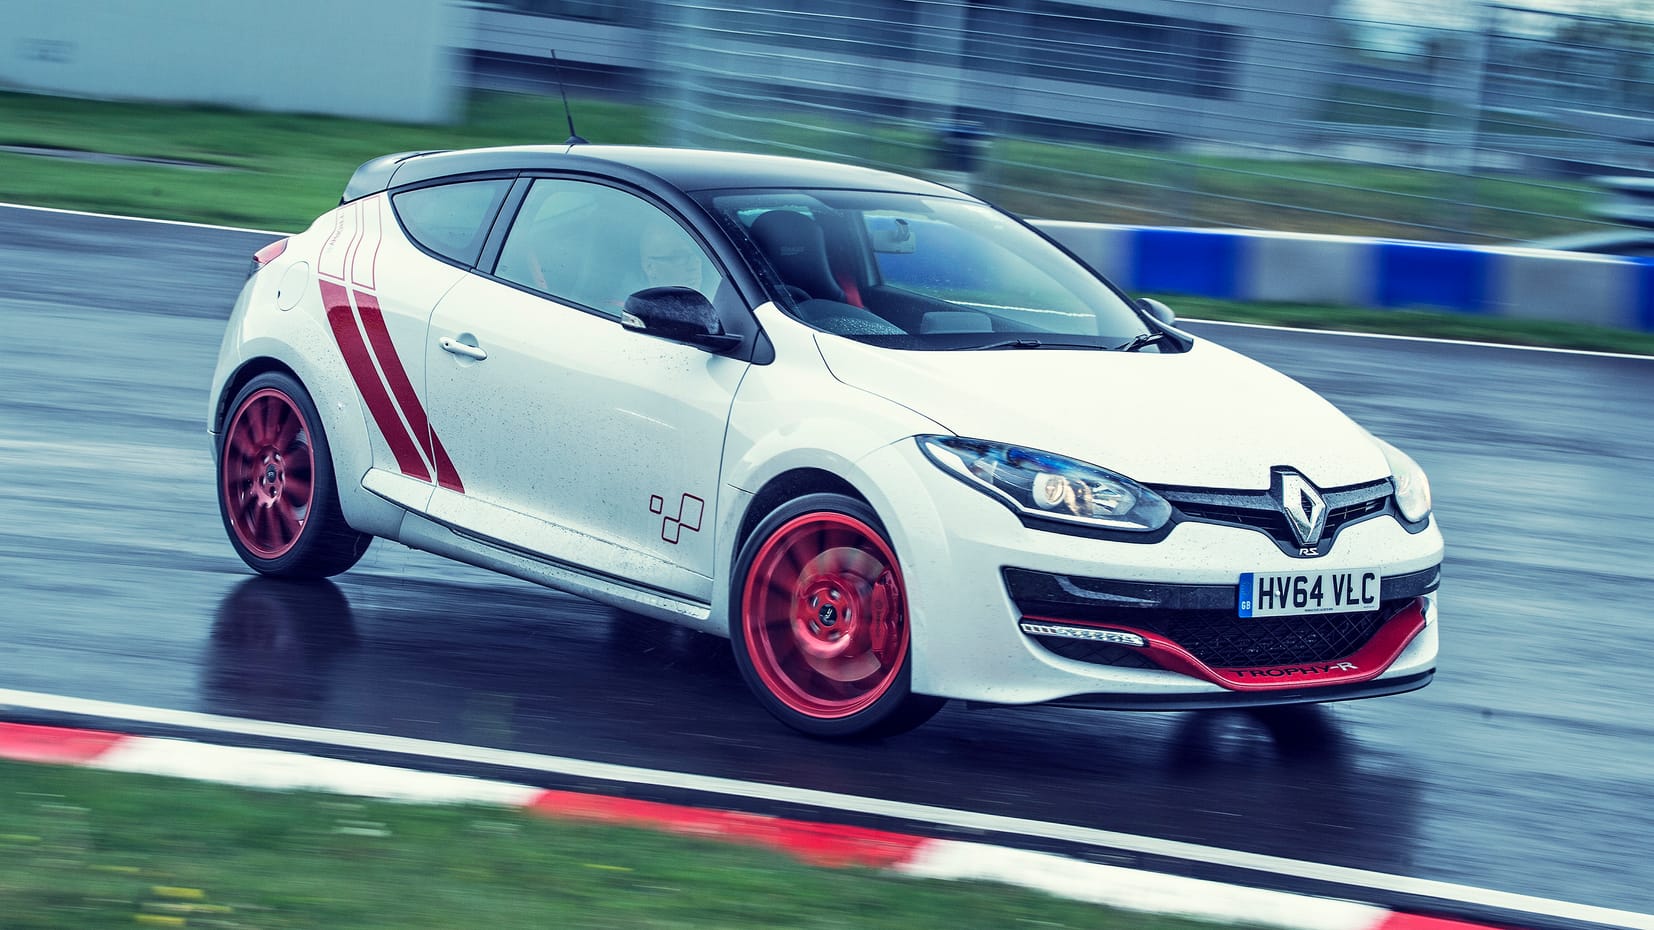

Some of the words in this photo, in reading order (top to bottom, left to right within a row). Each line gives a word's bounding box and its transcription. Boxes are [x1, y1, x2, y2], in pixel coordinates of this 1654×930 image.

[1299, 548, 1319, 556] RS
[1258, 575, 1323, 610] HV64
[1332, 572, 1375, 606] VLC
[1241, 601, 1251, 610] GB
[1229, 662, 1358, 677] TROPHY-R
